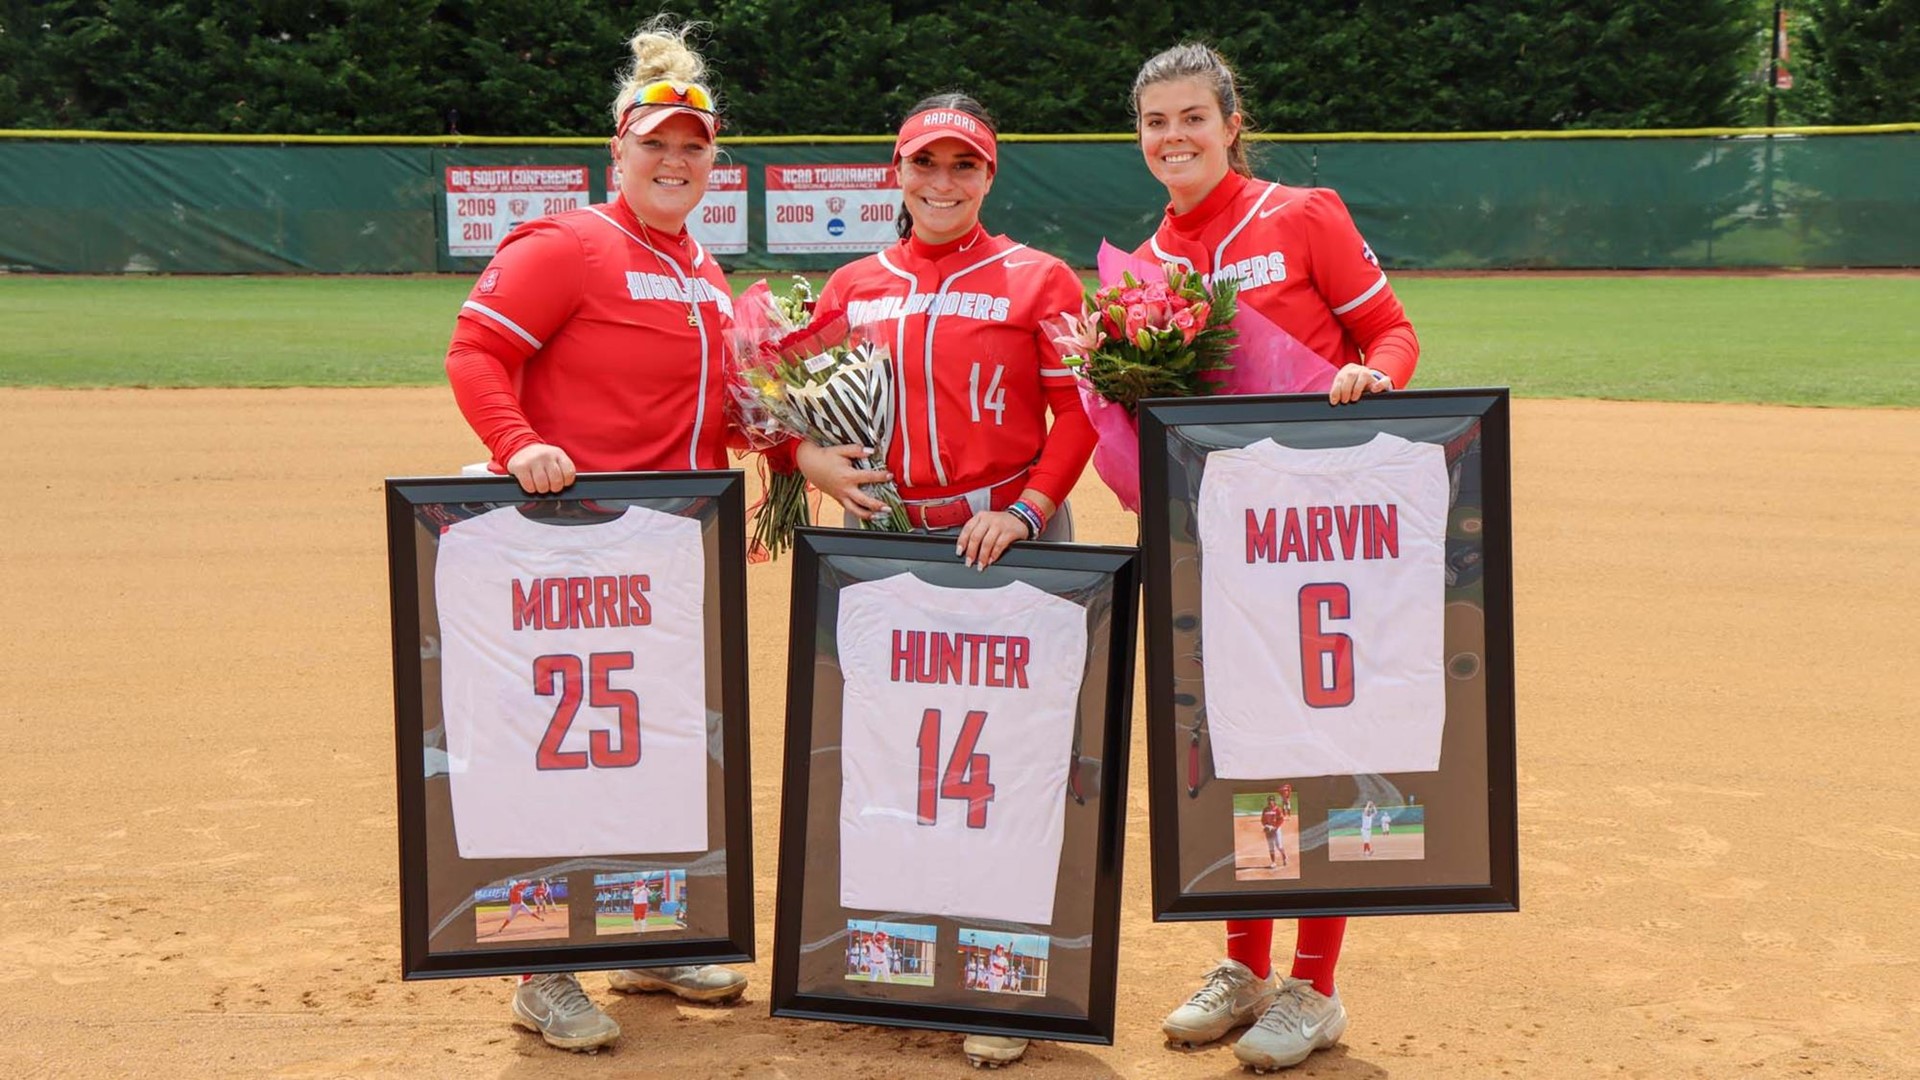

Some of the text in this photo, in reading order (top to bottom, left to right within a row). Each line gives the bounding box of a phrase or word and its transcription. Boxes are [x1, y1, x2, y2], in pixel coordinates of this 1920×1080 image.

[923, 112, 976, 133] RADFORD
[452, 169, 583, 186] BIG SOUTH CONFERENCE
[782, 167, 888, 183] NCAA TOURNAMENT
[457, 198, 496, 216] 2009
[543, 197, 577, 215] 2010
[702, 205, 736, 223] 2010
[776, 204, 814, 222] 2009
[860, 203, 894, 221] 2010
[463, 223, 492, 240] 2011
[969, 362, 1006, 426] 14
[1245, 503, 1399, 564] MARVIN
[512, 575, 652, 631] MORRIS
[1298, 582, 1355, 709] 6
[891, 629, 1030, 689] HUNTER
[532, 651, 642, 771] 25
[916, 708, 996, 829] 14
